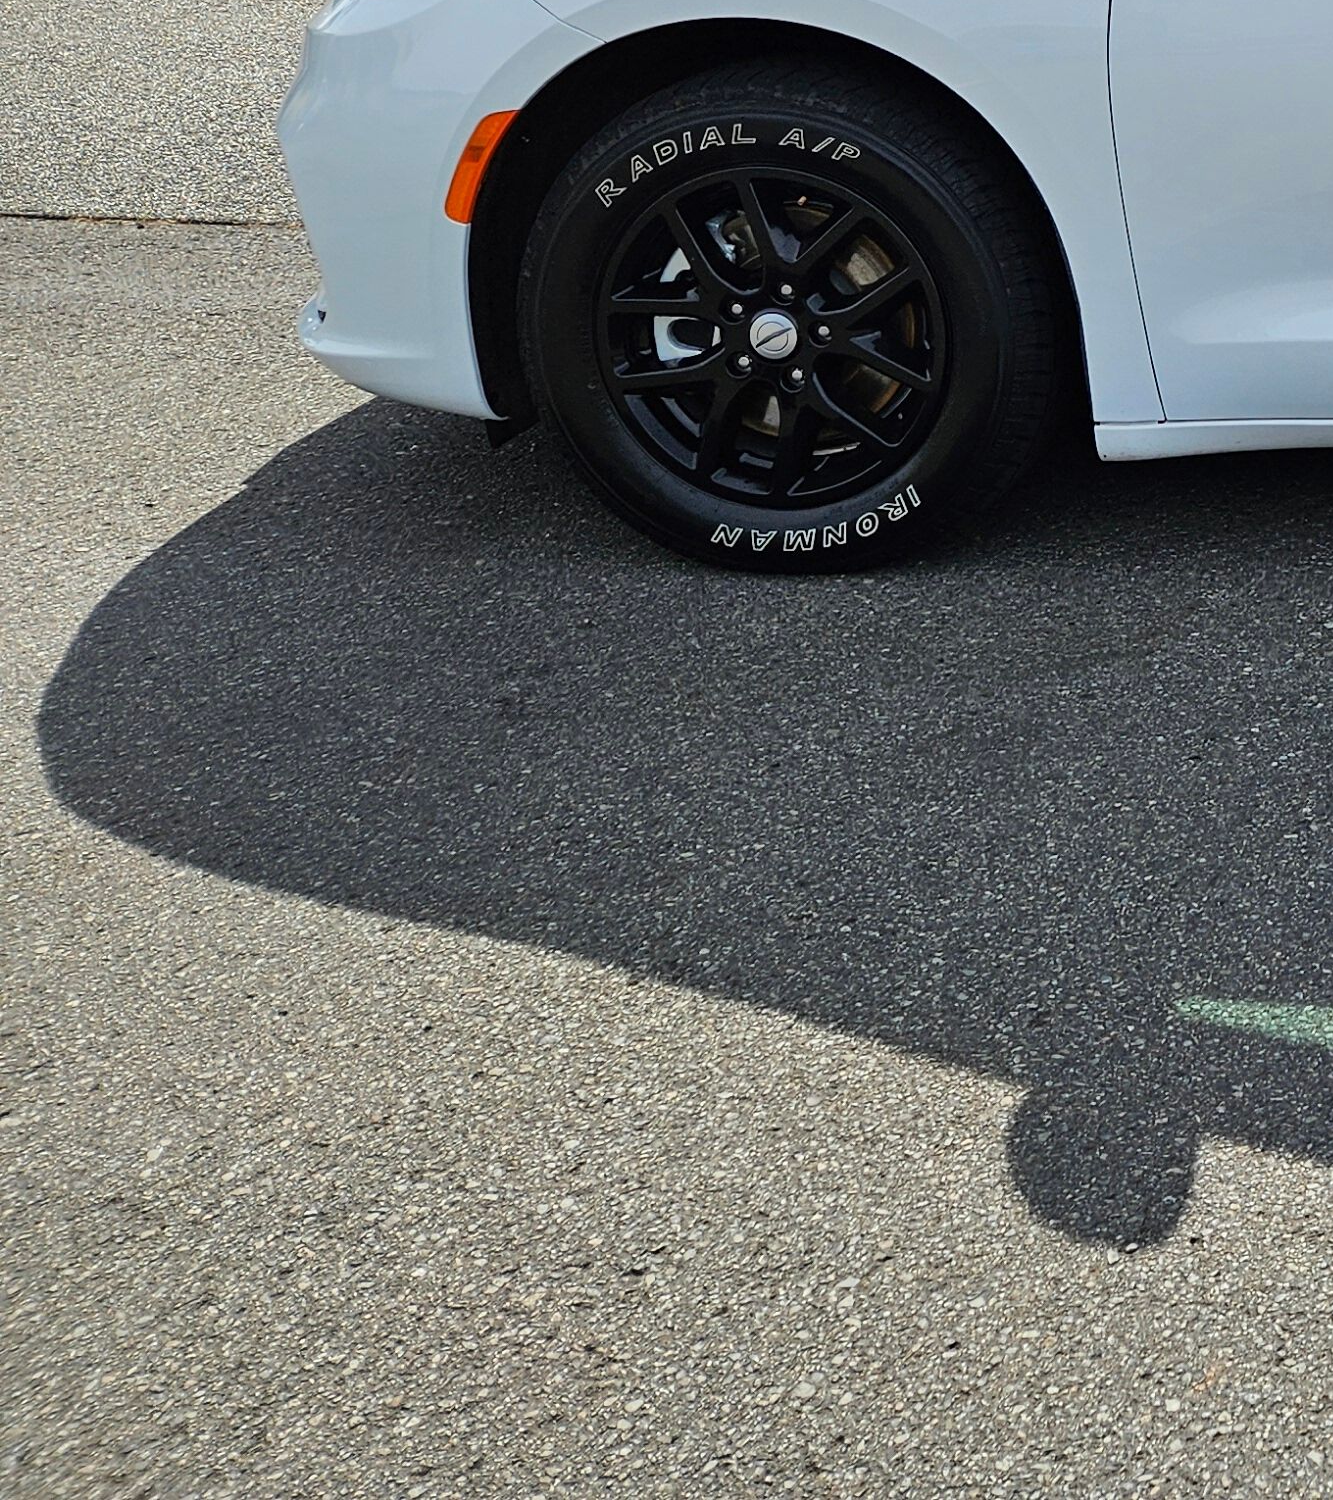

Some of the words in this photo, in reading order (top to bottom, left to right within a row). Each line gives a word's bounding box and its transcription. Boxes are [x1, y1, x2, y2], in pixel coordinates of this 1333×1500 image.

[595, 123, 757, 207] RADIAL
[778, 127, 861, 161] A/P
[711, 484, 922, 551] IRONMAN
